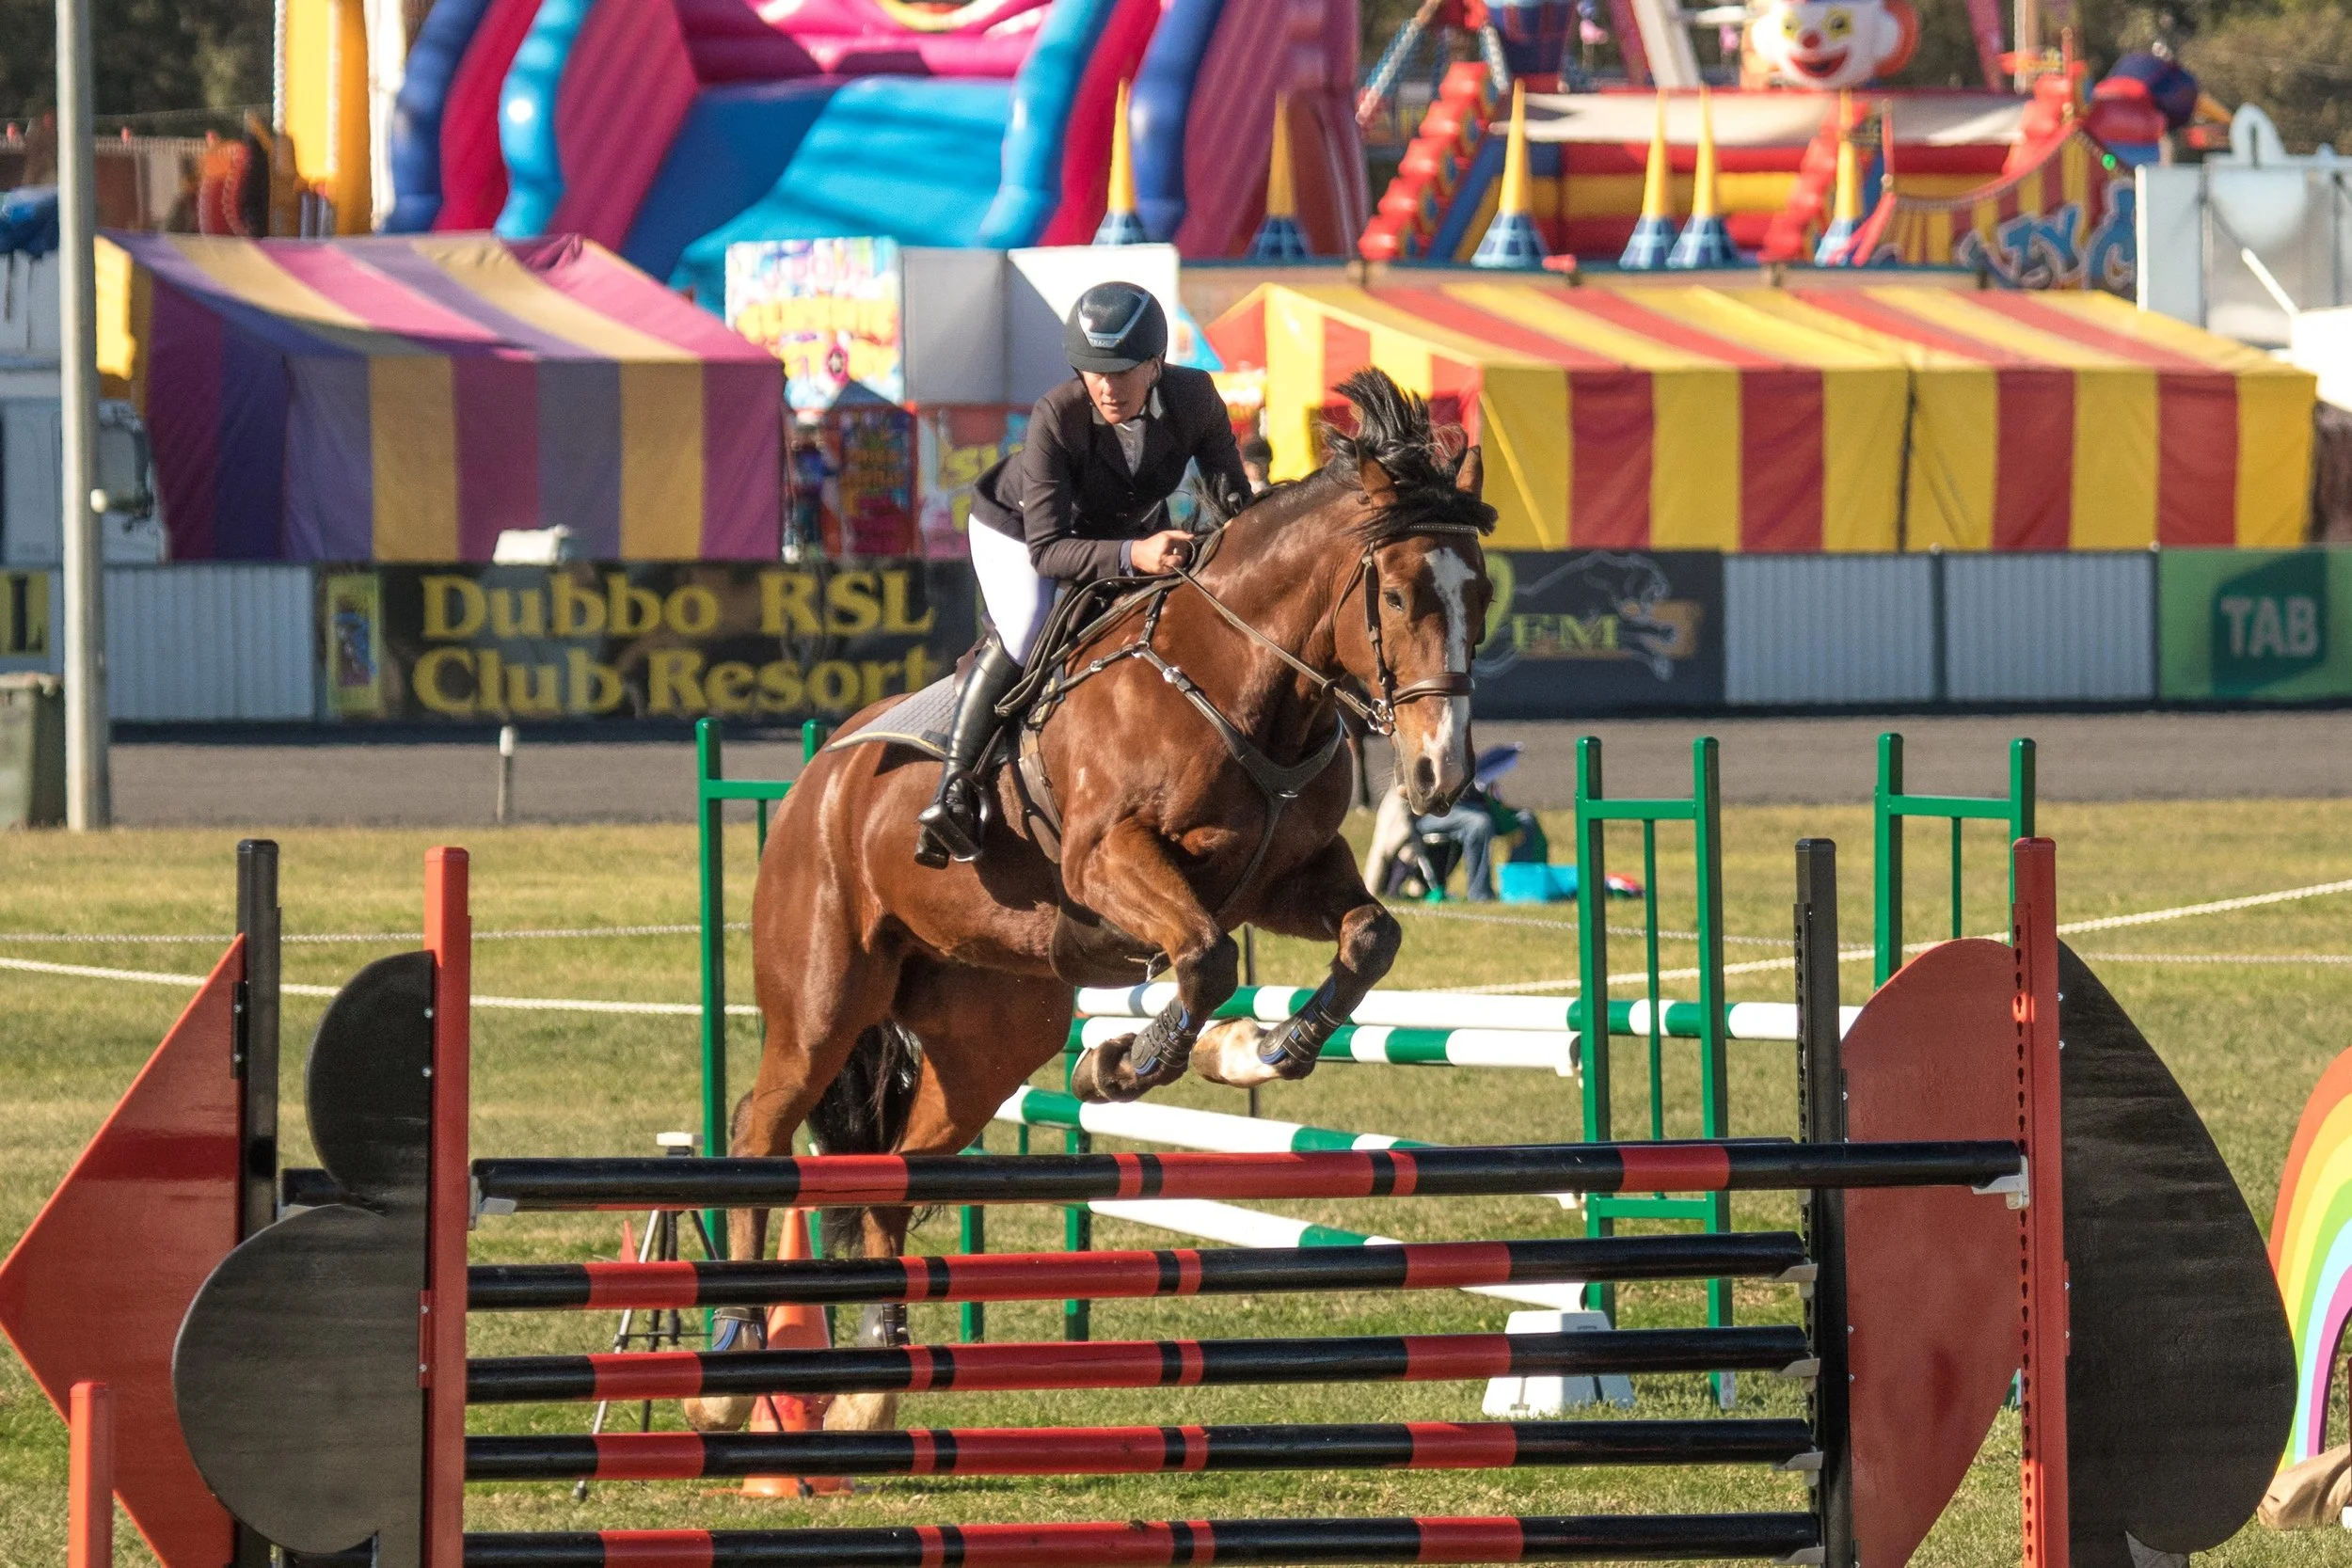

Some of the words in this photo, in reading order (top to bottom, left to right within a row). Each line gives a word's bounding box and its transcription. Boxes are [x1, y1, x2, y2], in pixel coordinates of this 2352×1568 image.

[421, 571, 721, 638] Dubbo
[761, 571, 934, 637] RSL
[2220, 597, 2318, 657] TAB
[412, 646, 624, 713] Club
[650, 645, 939, 714] Resort
